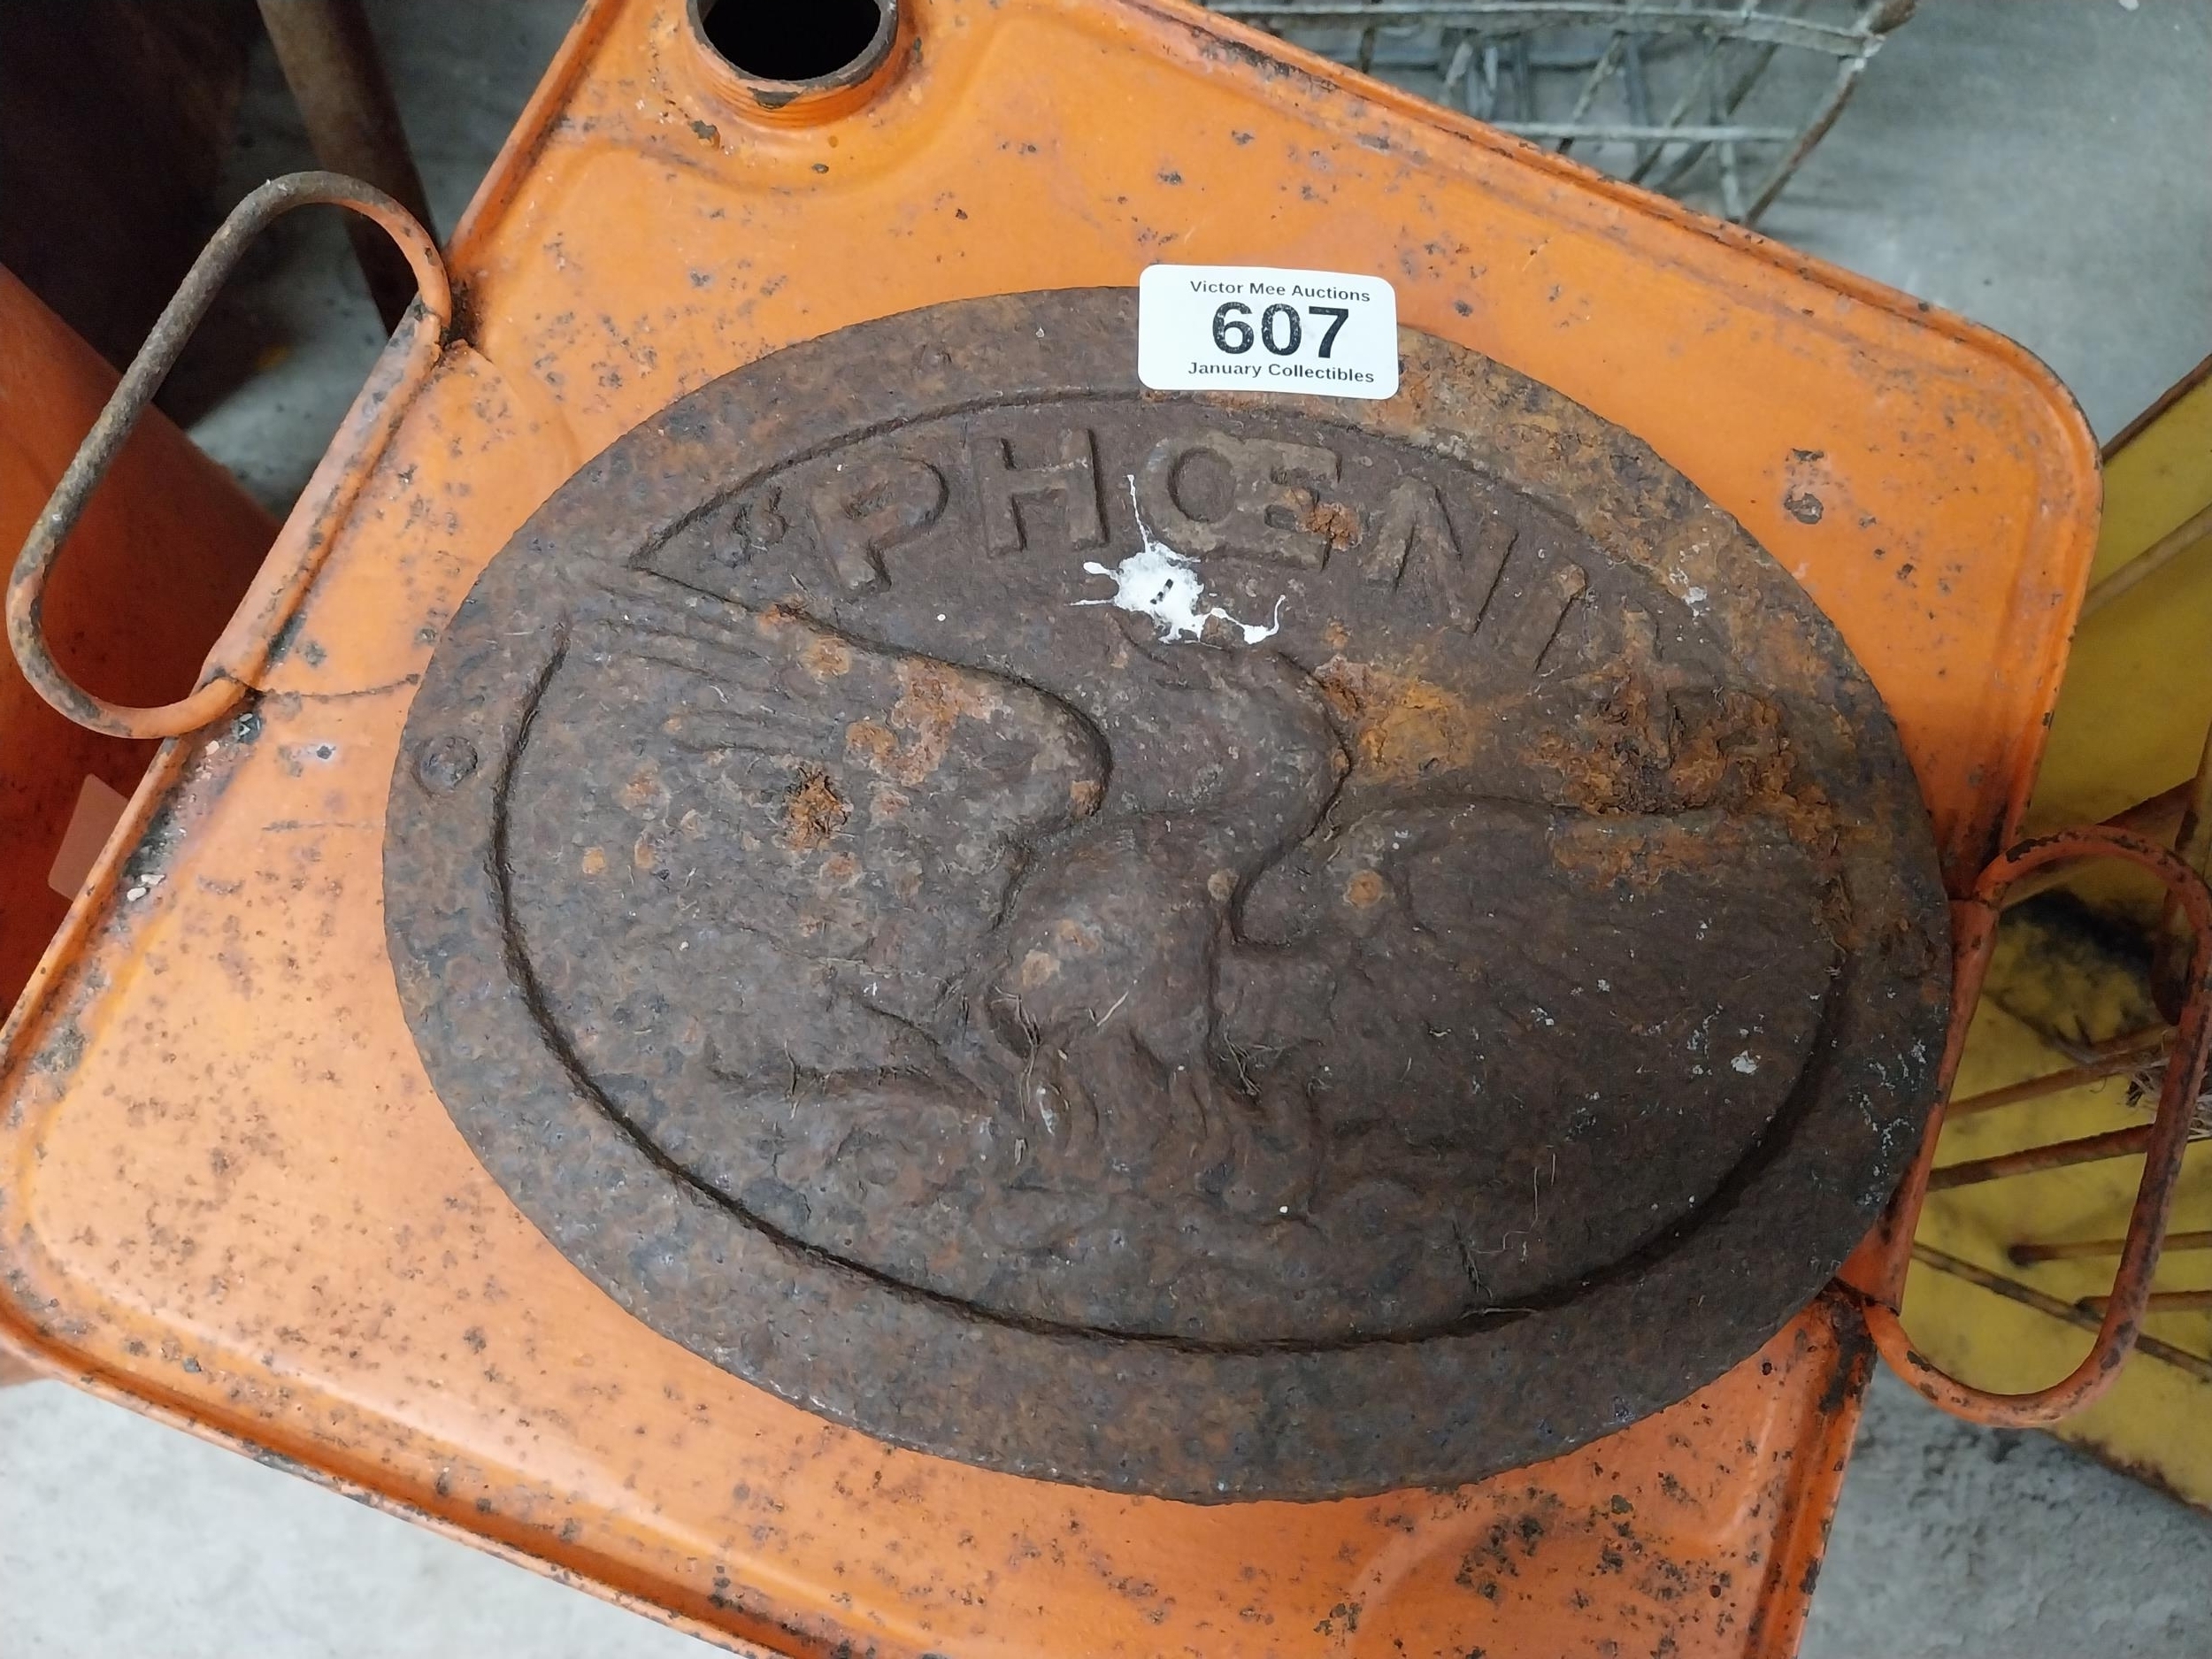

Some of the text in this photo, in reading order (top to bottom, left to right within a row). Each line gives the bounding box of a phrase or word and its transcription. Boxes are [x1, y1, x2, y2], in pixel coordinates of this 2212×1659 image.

[1190, 280, 1371, 302] Victor Mee Auctions
[1213, 301, 1349, 359] 607
[1188, 362, 1375, 383] January Collectibles
